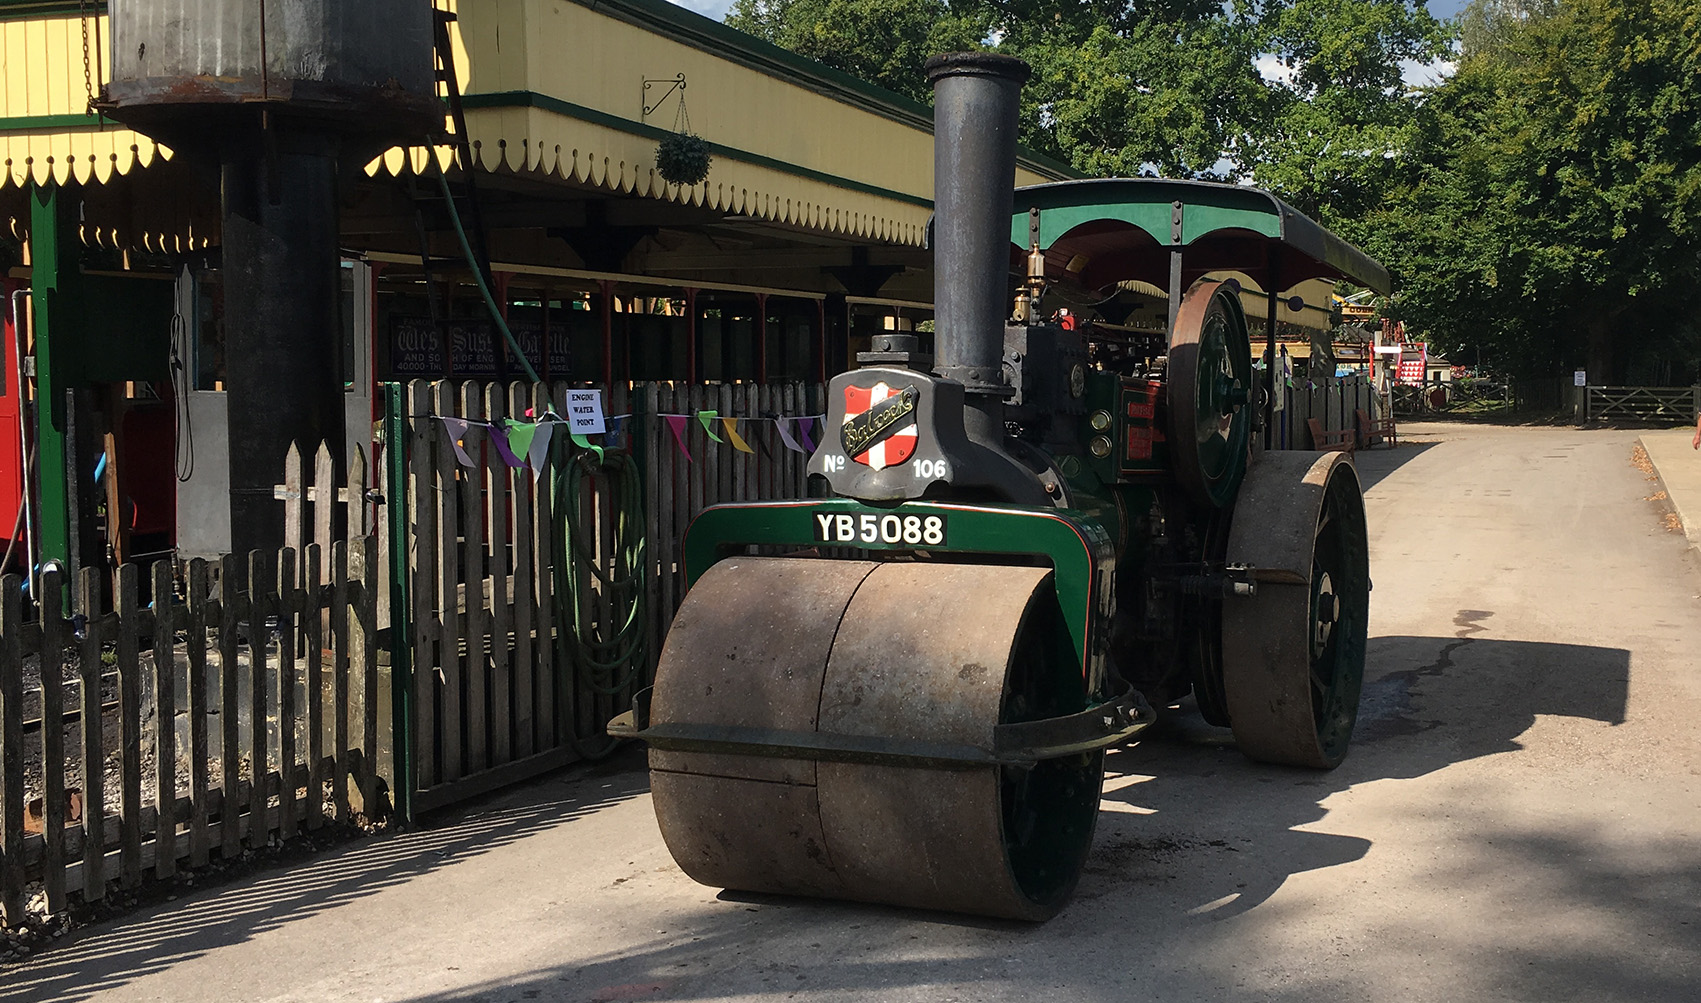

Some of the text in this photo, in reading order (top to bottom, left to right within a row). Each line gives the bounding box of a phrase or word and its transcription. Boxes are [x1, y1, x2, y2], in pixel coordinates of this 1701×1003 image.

[397, 325, 438, 352] Wes
[404, 353, 425, 362] AND
[461, 354, 473, 363] OF
[469, 361, 495, 370] MORNIN
[573, 406, 594, 414] WATER
[576, 418, 594, 426] POINT
[912, 459, 946, 478] 106
